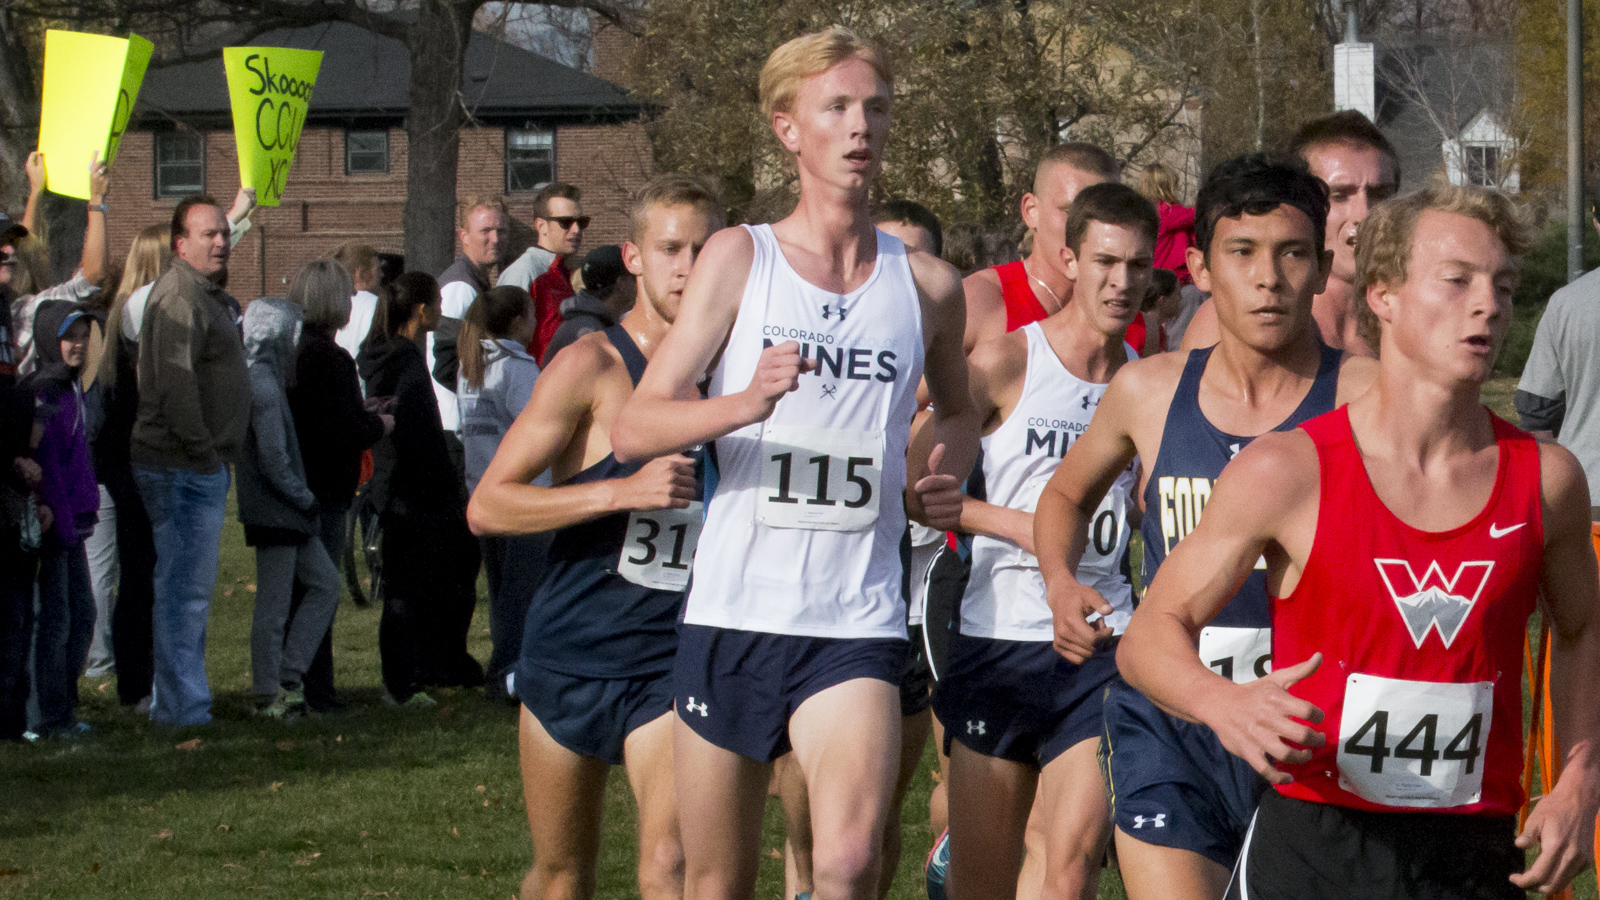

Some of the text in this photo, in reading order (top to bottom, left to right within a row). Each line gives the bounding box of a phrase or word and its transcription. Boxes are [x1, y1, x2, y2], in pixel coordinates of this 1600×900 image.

[264, 158, 288, 200] XC
[762, 325, 834, 344] COLORADO
[762, 337, 898, 383] INES
[1025, 427, 1081, 459] MI
[768, 452, 874, 509] 115
[627, 517, 697, 571] 31
[1373, 558, 1496, 650] W
[1344, 710, 1483, 777] 444
